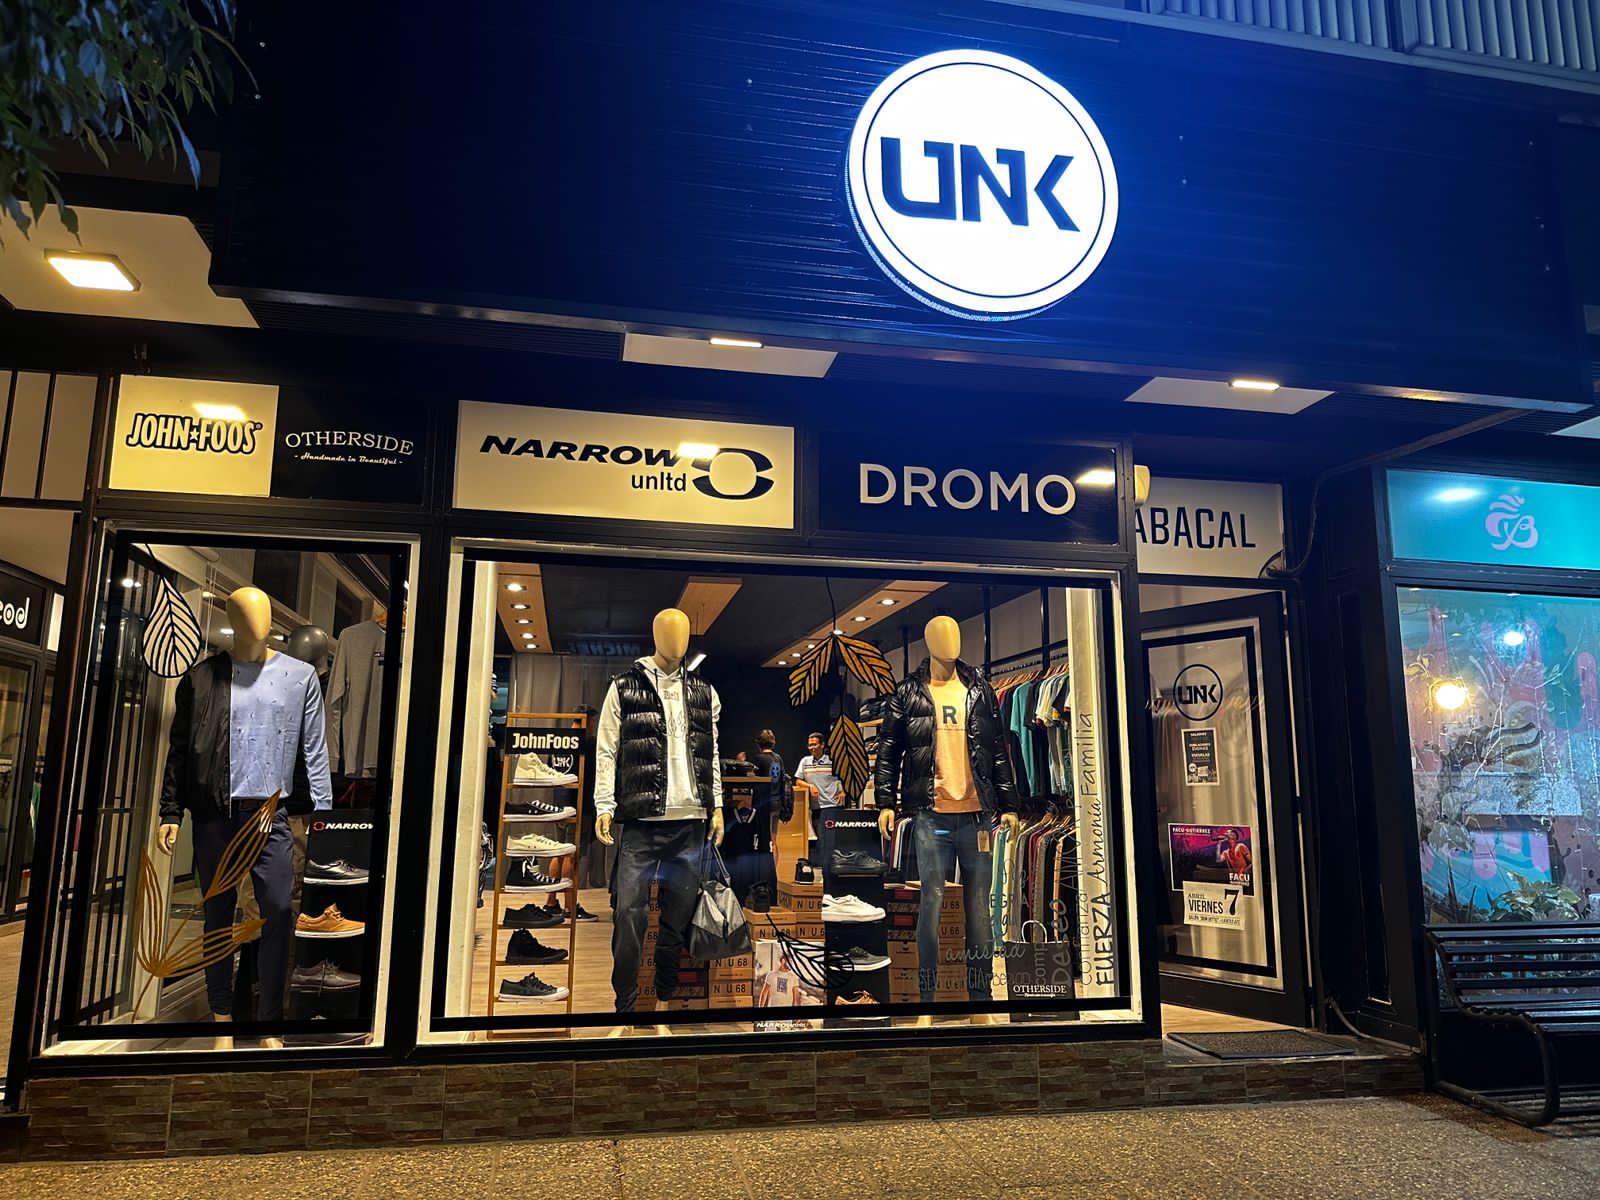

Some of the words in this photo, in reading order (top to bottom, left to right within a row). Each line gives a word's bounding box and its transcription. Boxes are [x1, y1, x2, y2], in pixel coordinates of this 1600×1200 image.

[880, 136, 1081, 232] UNK
[285, 431, 414, 455] OTHERSIDE
[479, 435, 681, 467] NARROW
[301, 452, 345, 462] Handmade
[631, 472, 686, 491] unltd
[859, 463, 1076, 515] DROMO
[942, 704, 958, 725] R
[512, 732, 580, 750] JohnFoos
[1074, 713, 1098, 796] Familia
[835, 820, 877, 829] NARROW
[1229, 872, 1250, 882] FACU
[1188, 899, 1224, 914] VIERNES
[1224, 889, 1240, 916] 7
[1092, 892, 1116, 986] FUERZA
[1013, 984, 1067, 994] OTHERSIDE
